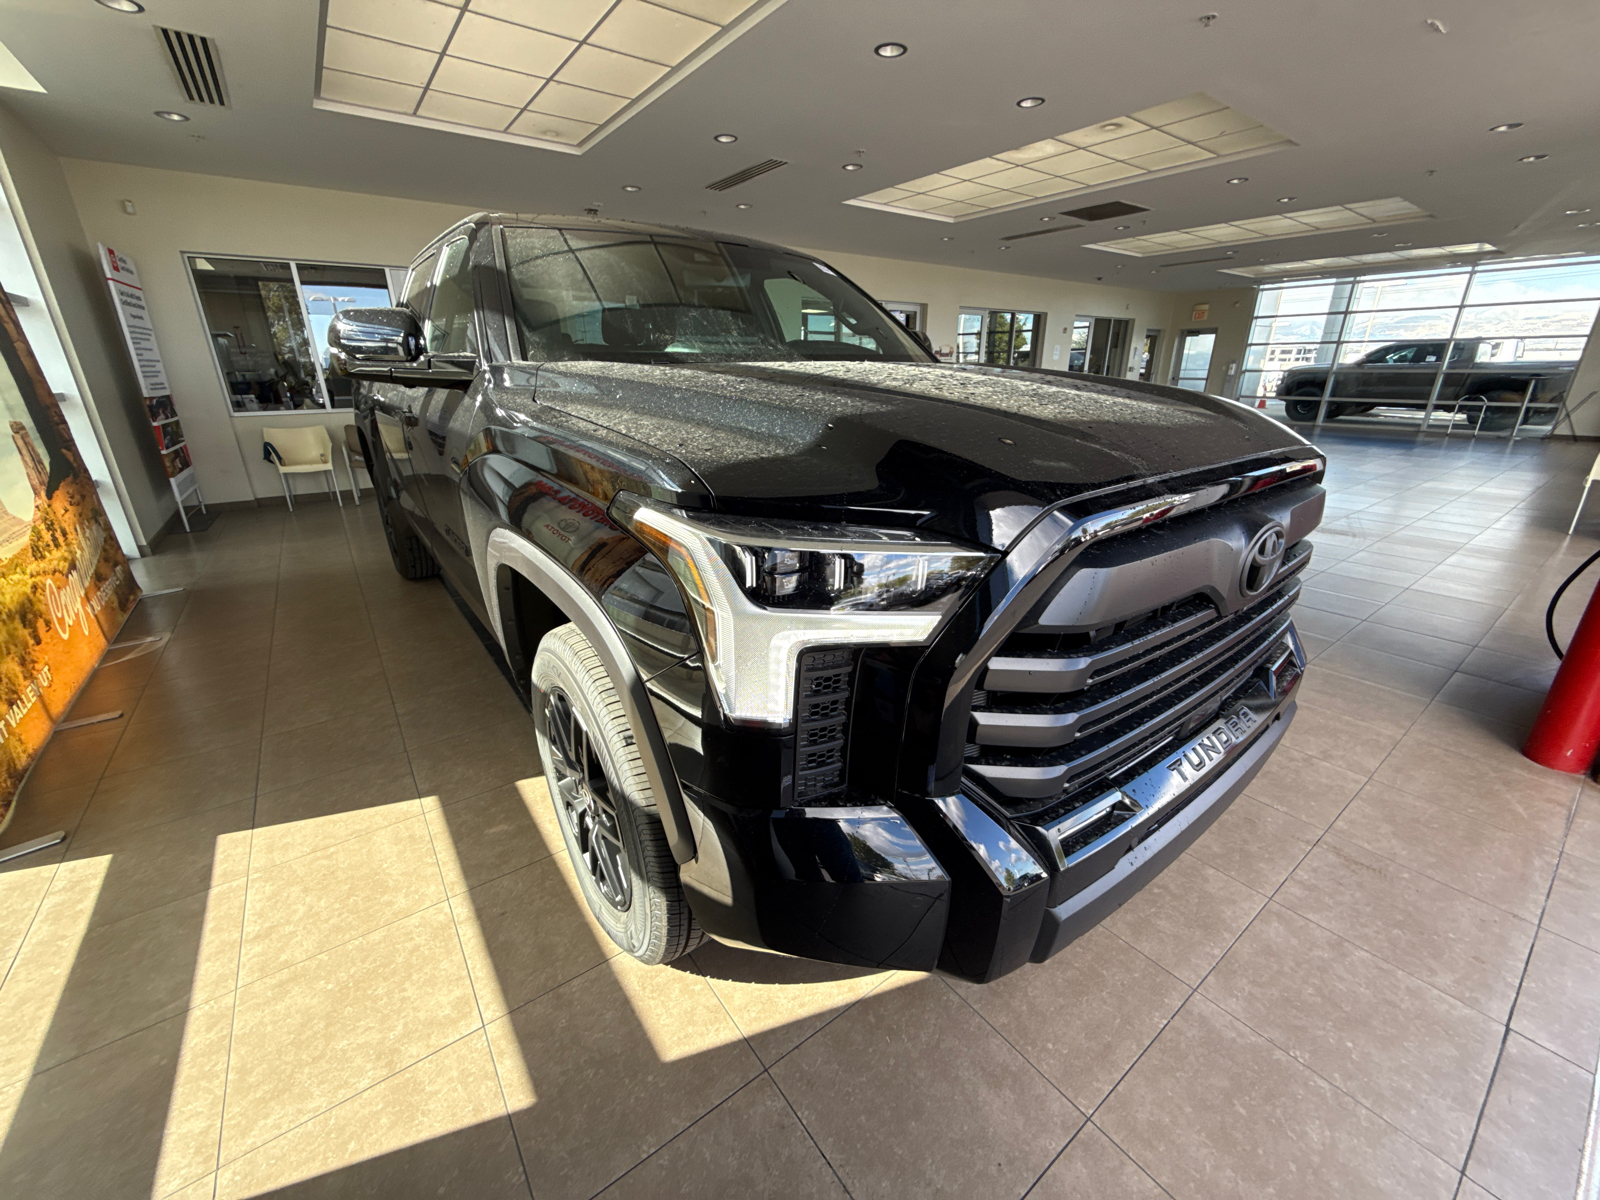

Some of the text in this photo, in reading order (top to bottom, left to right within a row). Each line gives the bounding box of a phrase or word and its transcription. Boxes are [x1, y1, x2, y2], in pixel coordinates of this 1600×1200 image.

[1193, 310, 1206, 320] EXIT
[85, 595, 101, 619] YOU
[6, 678, 43, 728] VALLEY,
[38, 665, 52, 687] UT
[1166, 706, 1257, 782] TUNDRA
